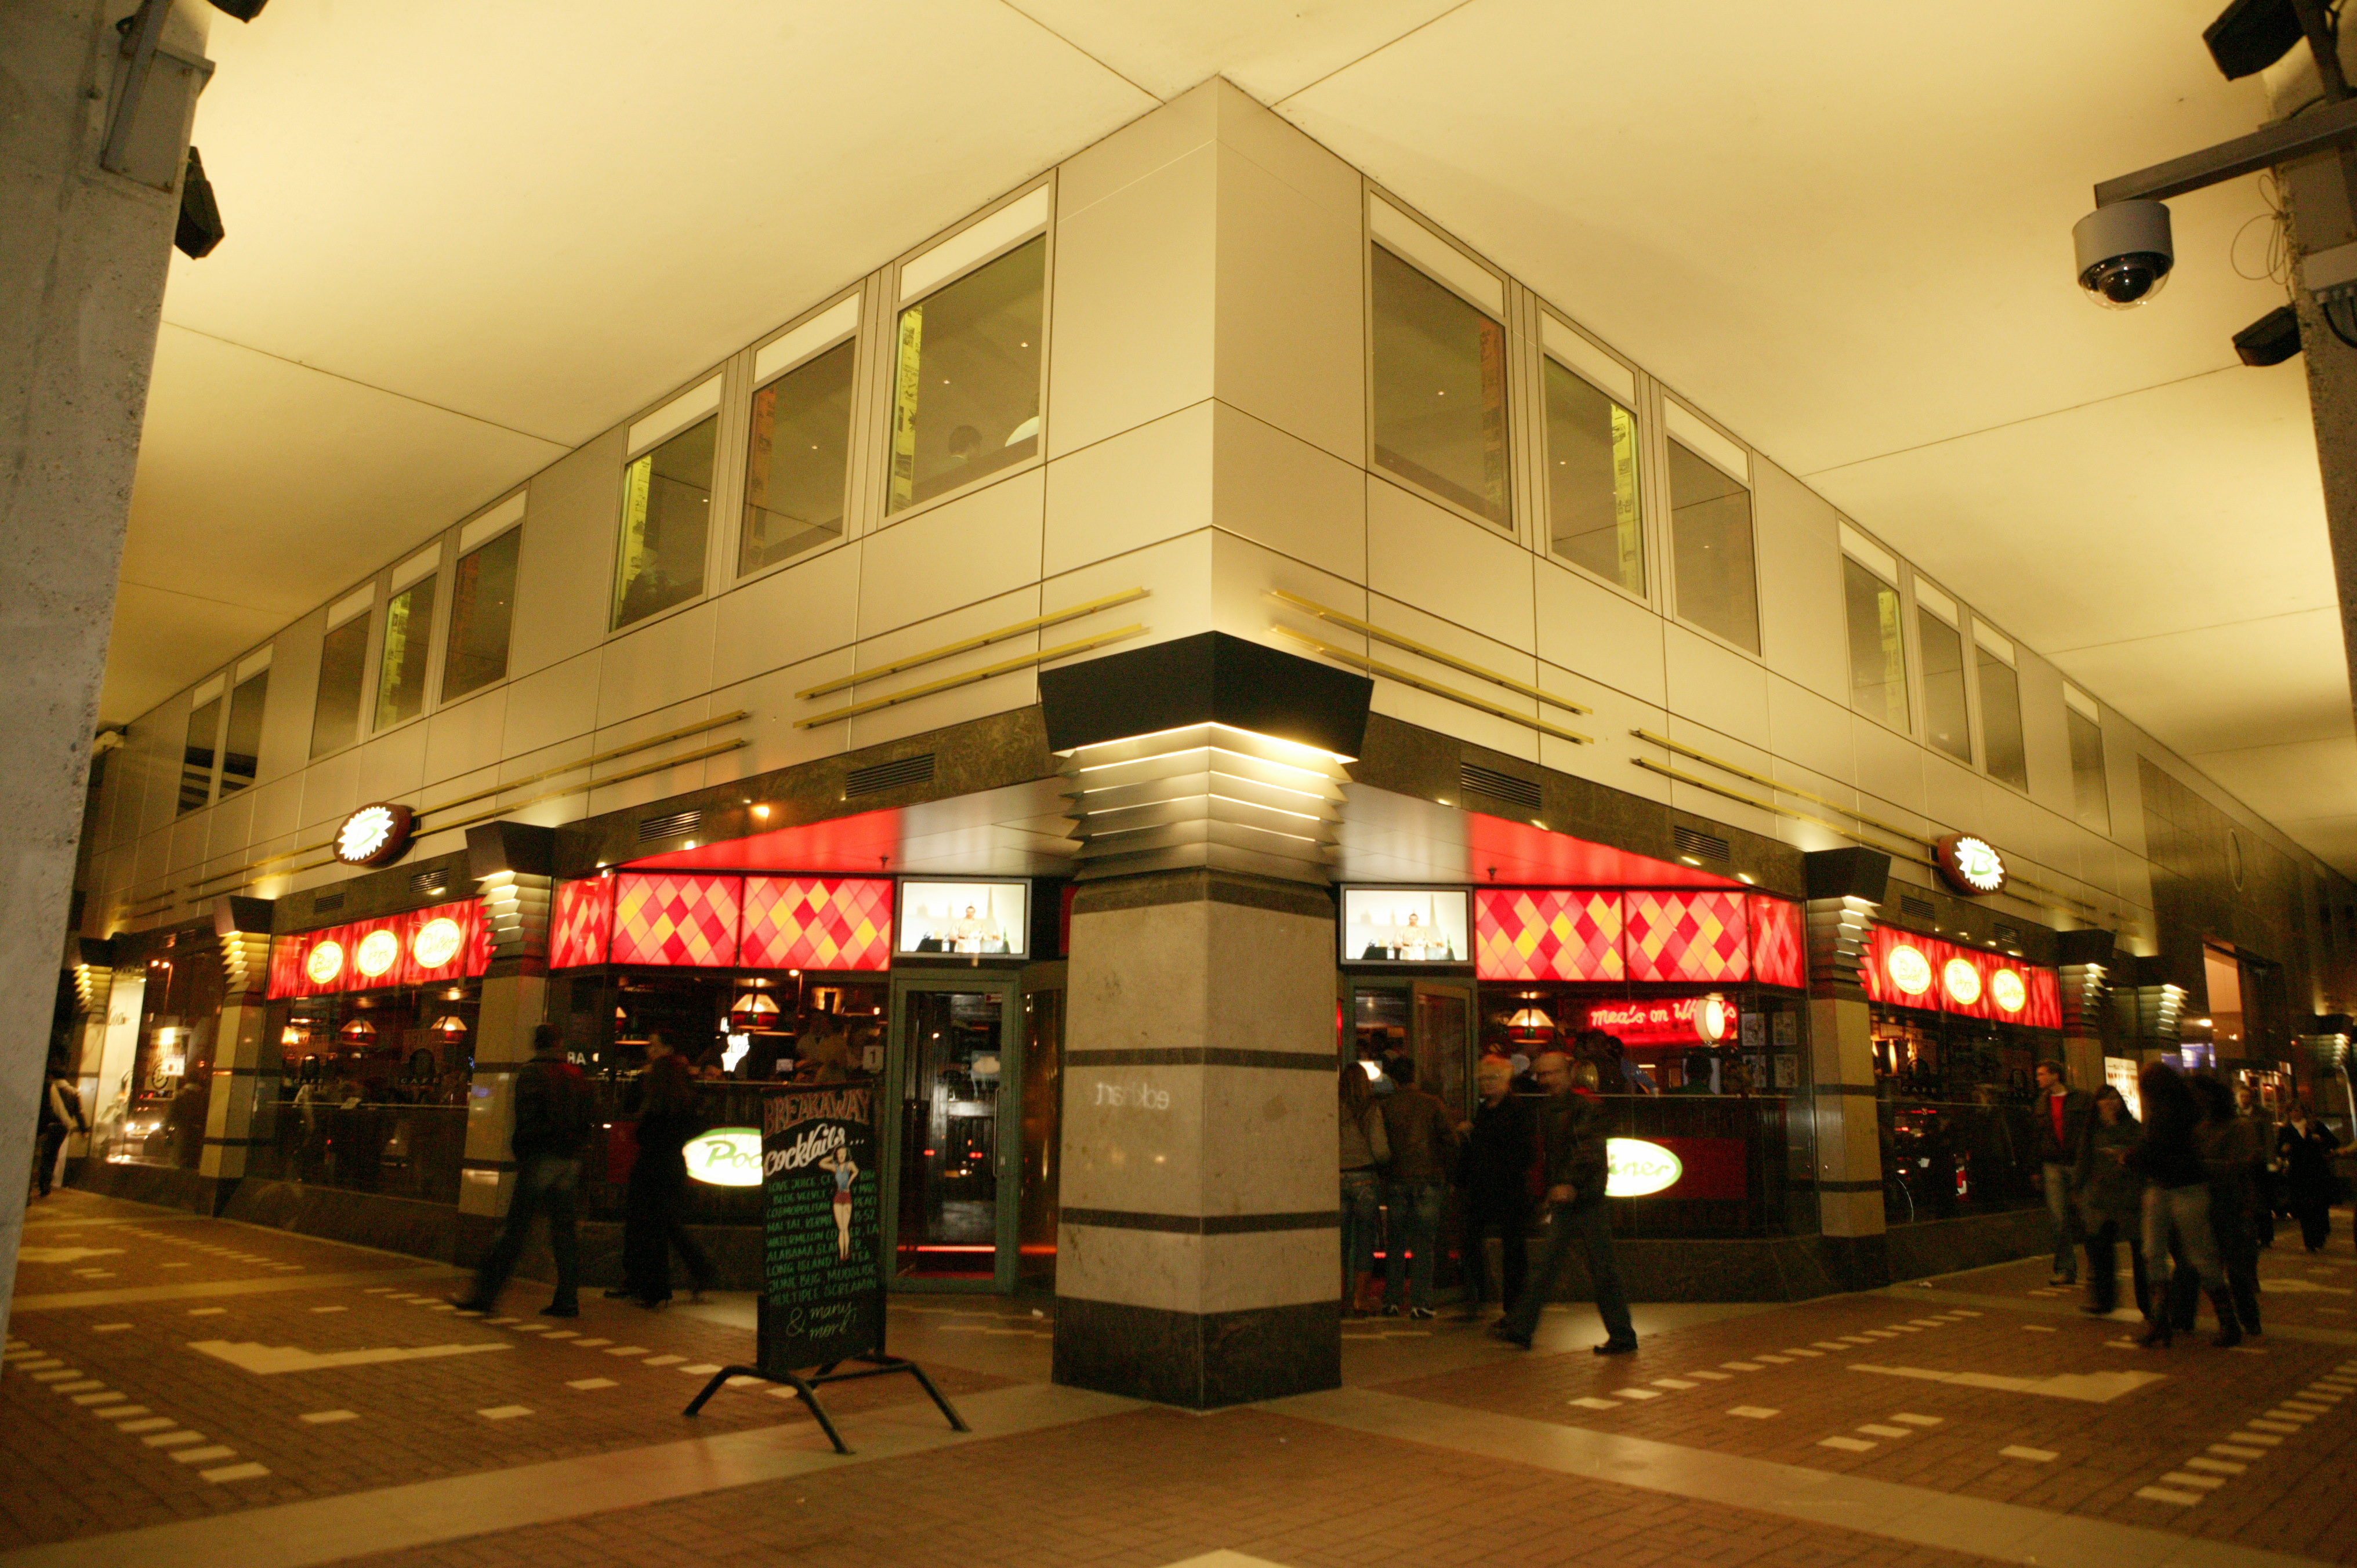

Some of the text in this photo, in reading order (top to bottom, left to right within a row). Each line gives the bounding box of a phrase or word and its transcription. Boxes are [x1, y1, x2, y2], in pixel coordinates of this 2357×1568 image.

[1970, 845, 1993, 876] B
[1650, 1009, 1669, 1023] on
[764, 1089, 871, 1138] BREAKAWAY
[705, 1141, 763, 1170] Poo
[1608, 1153, 1670, 1177] iner
[786, 1306, 805, 1337] &
